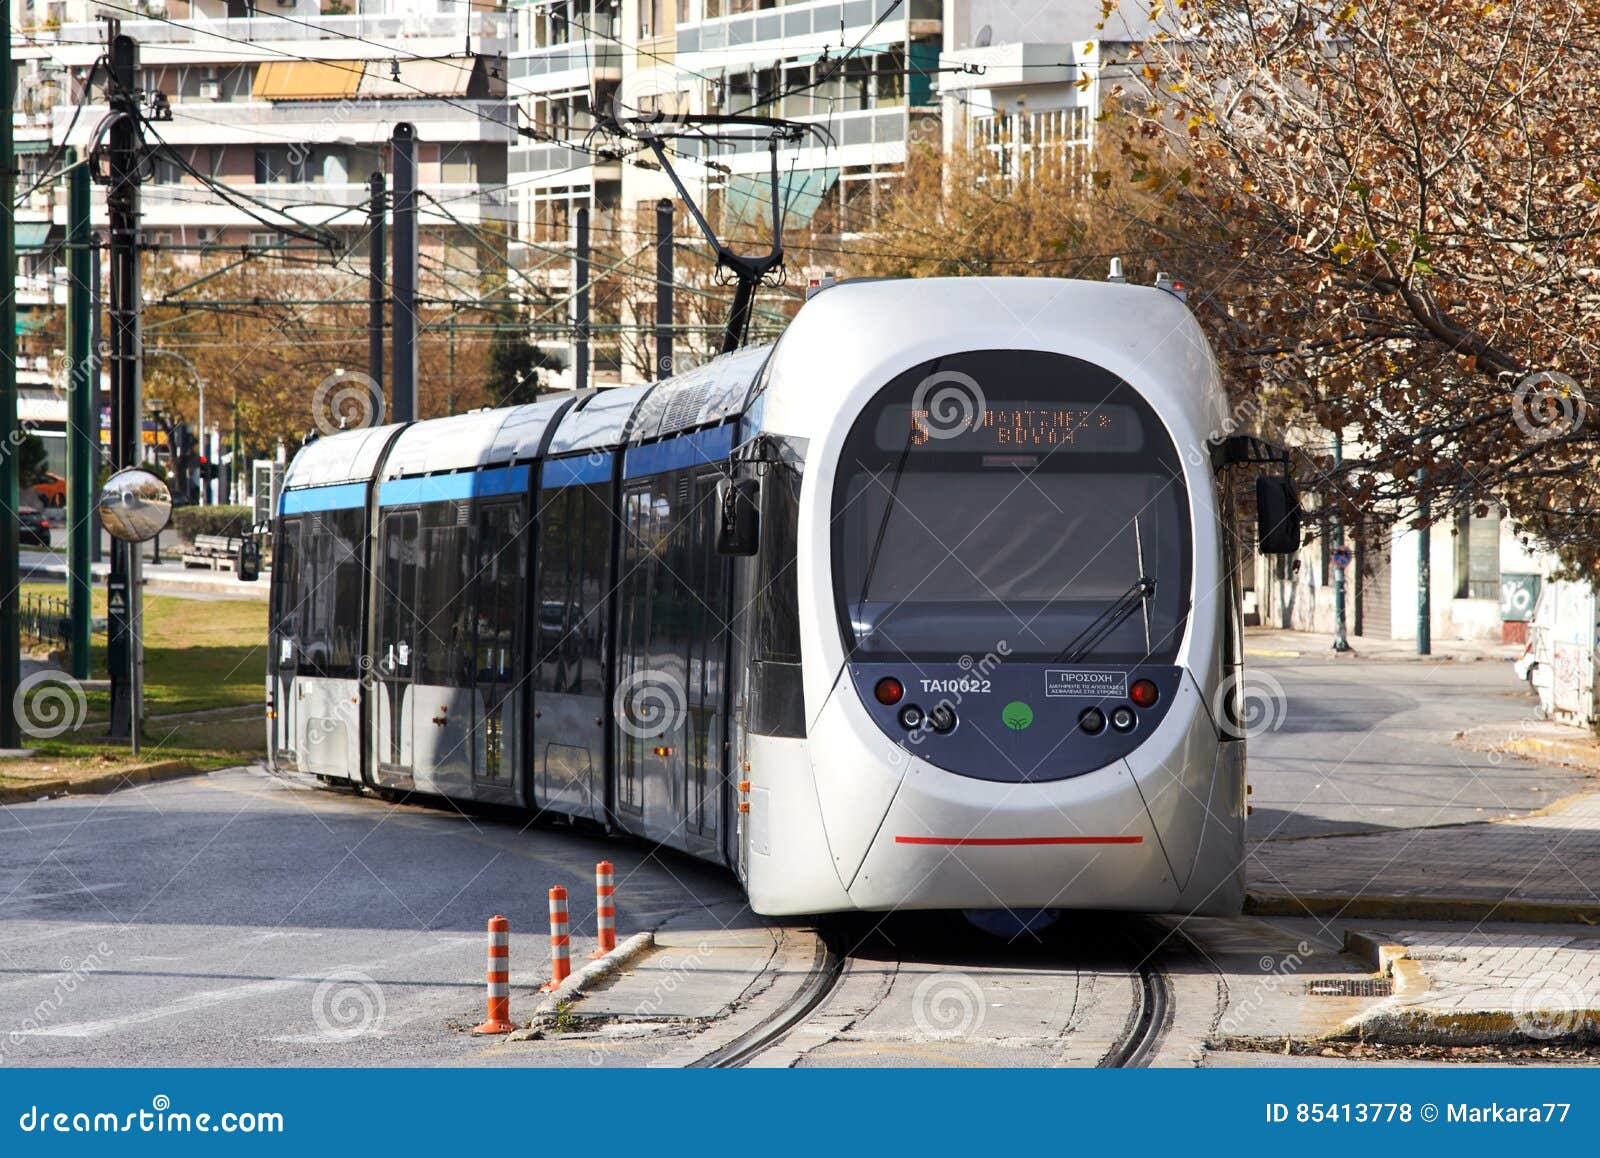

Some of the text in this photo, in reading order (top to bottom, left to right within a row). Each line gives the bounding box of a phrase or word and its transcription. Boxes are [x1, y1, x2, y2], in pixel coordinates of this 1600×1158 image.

[912, 409, 929, 445] 5
[1061, 673, 1113, 683] ΠΡΟΣΟΧΗ
[920, 679, 992, 693] TA10022
